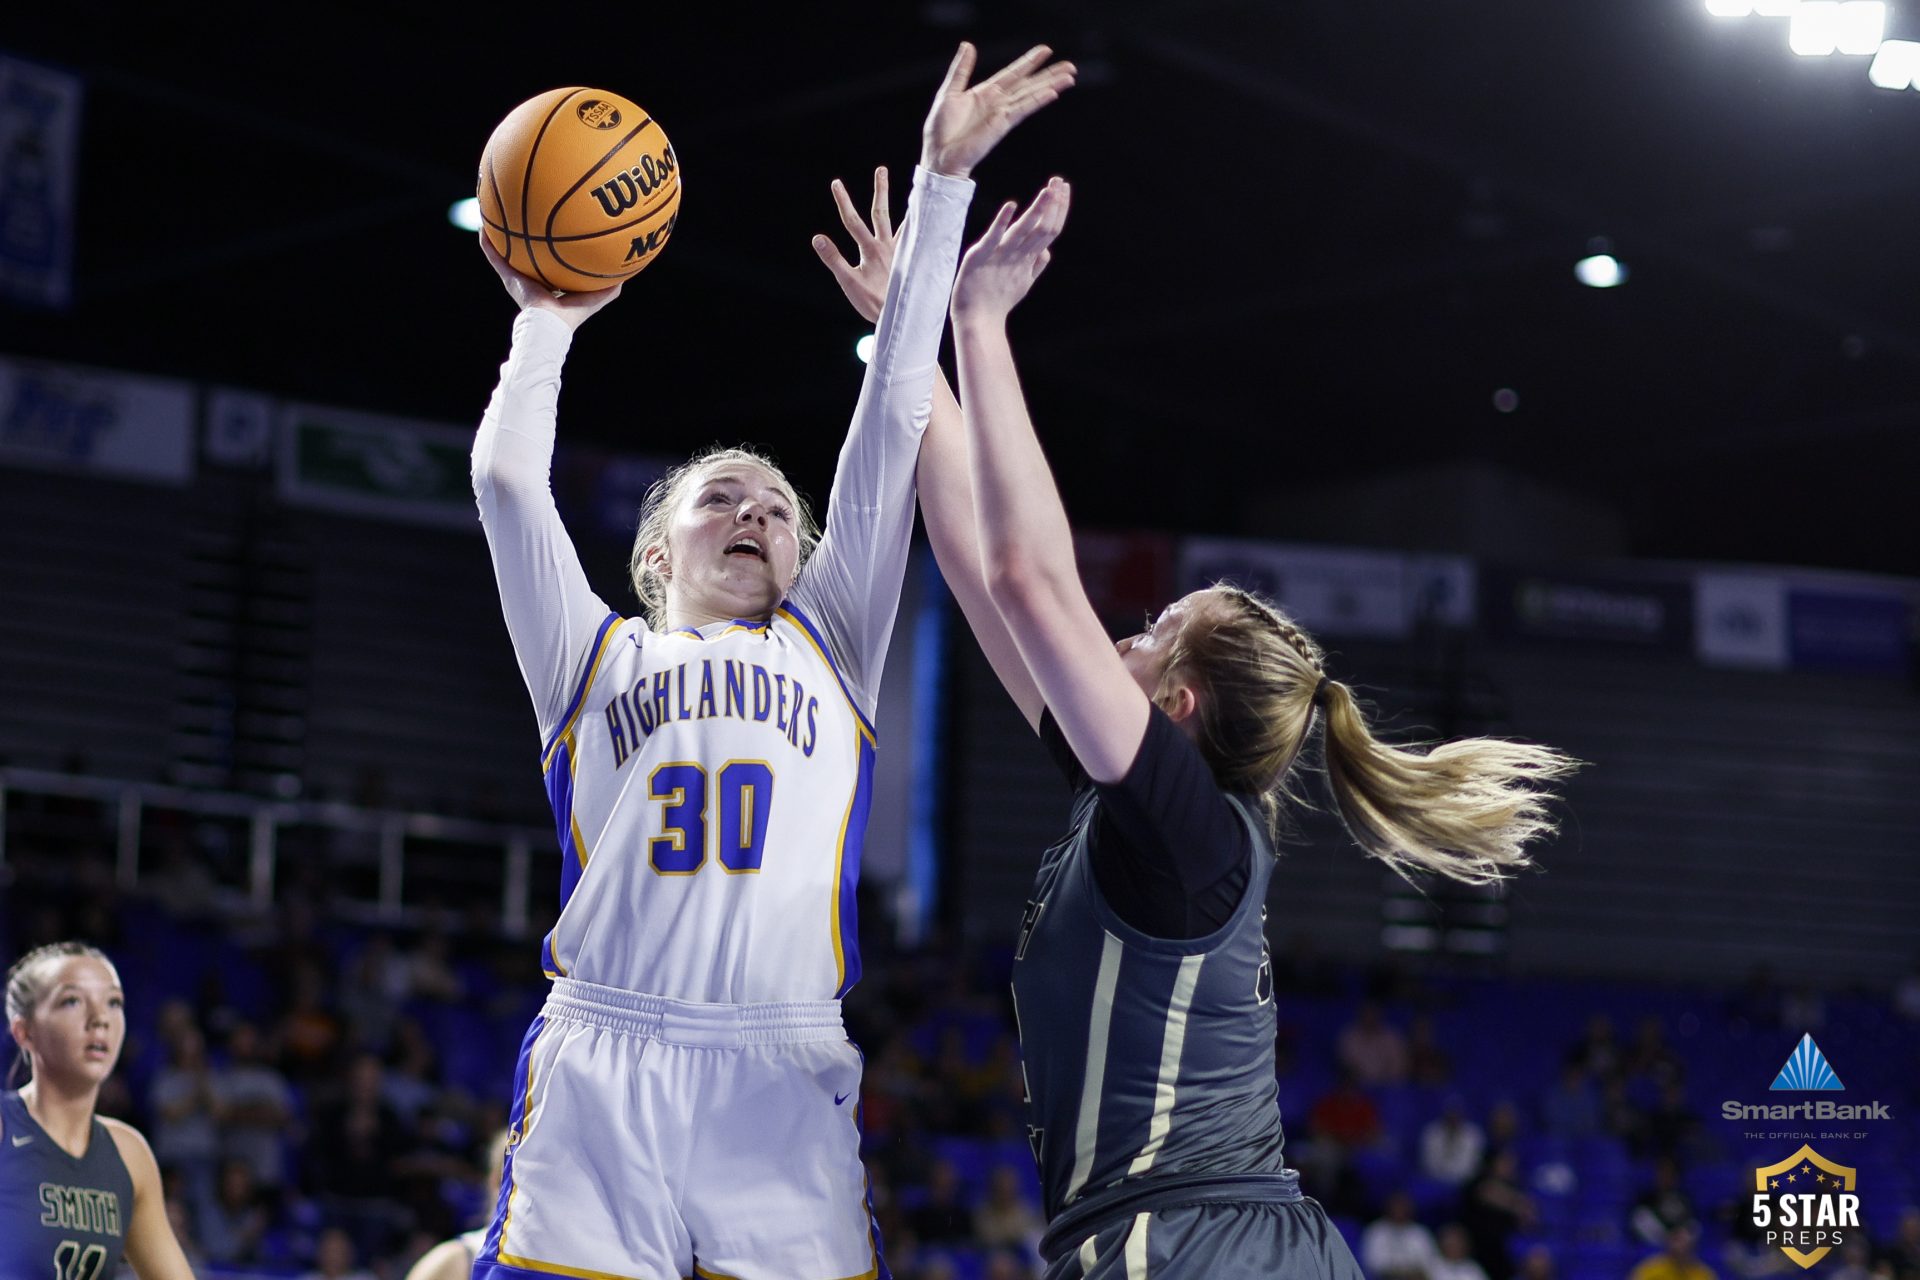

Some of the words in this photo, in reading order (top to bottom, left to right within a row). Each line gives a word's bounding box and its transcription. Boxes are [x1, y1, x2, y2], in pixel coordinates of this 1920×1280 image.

[585, 103, 611, 123] TSSAA
[604, 659, 819, 771] HIGHLANDERS
[647, 758, 775, 876] 30
[39, 1182, 121, 1237] SMITH
